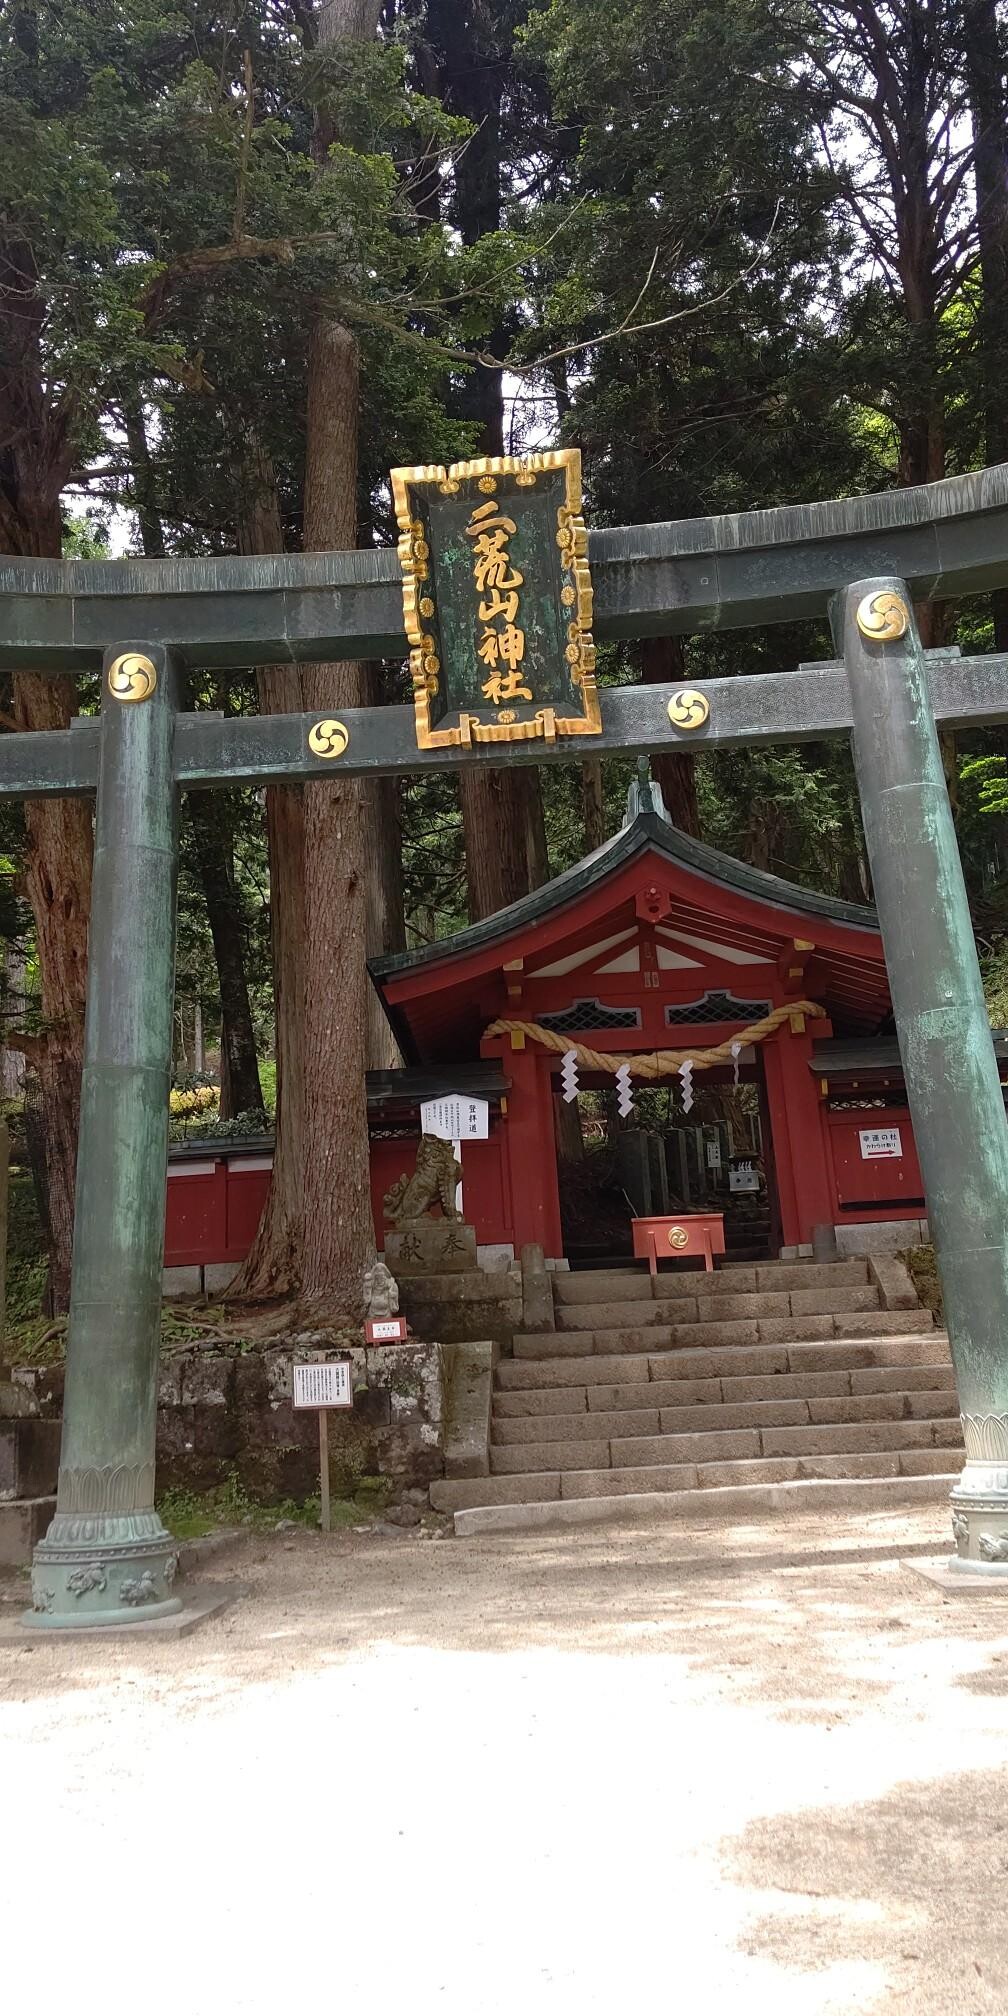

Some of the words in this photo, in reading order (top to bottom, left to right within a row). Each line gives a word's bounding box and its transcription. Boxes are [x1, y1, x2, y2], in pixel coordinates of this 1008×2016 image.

[465, 500, 532, 704] 二荒山神社
[469, 1104, 477, 1133] 登拝道
